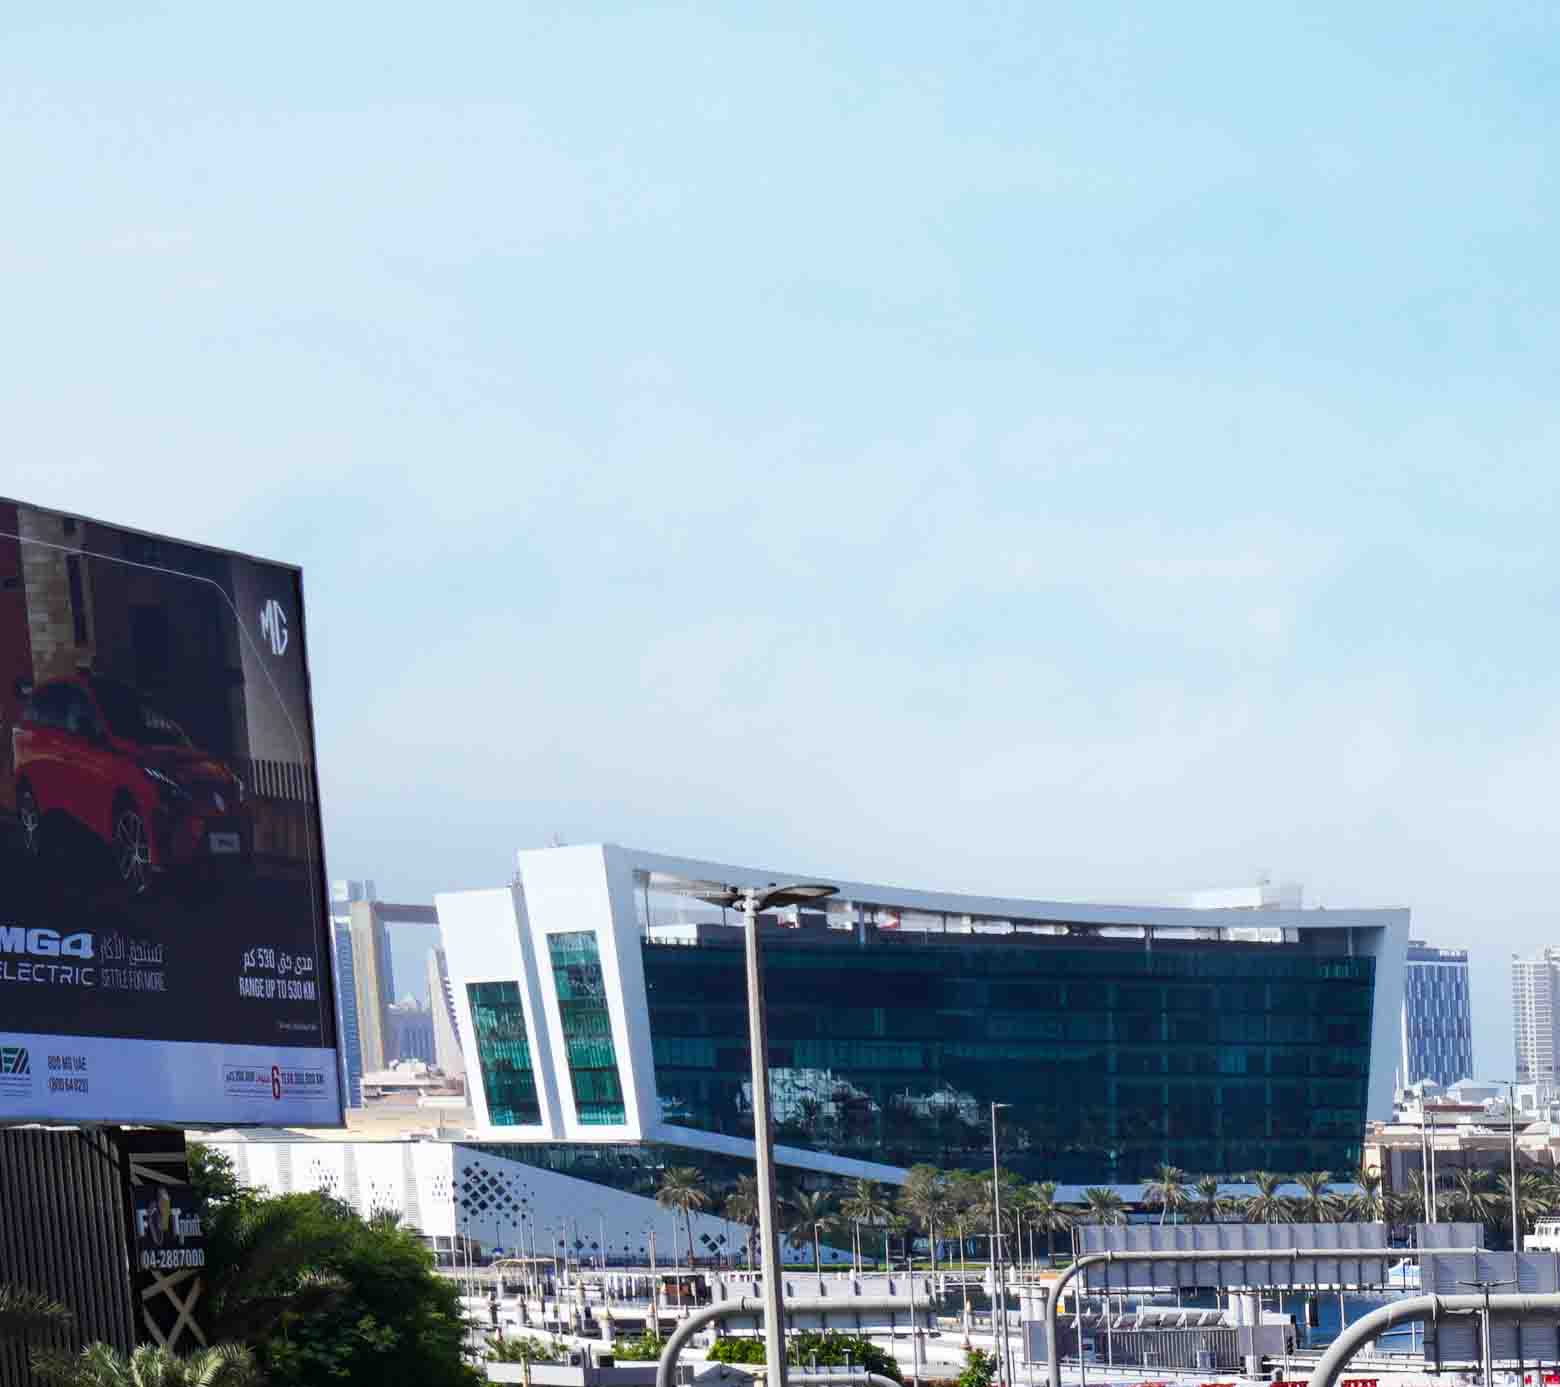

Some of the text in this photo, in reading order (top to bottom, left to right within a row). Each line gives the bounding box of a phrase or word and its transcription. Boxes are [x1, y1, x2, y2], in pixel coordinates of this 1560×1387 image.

[260, 599, 289, 656] MG
[0, 926, 95, 959] MG4
[239, 976, 264, 998] RANGE
[265, 977, 276, 999] UP
[277, 978, 287, 999] TO
[288, 980, 303, 1000] 530
[271, 1065, 281, 1100] 6
